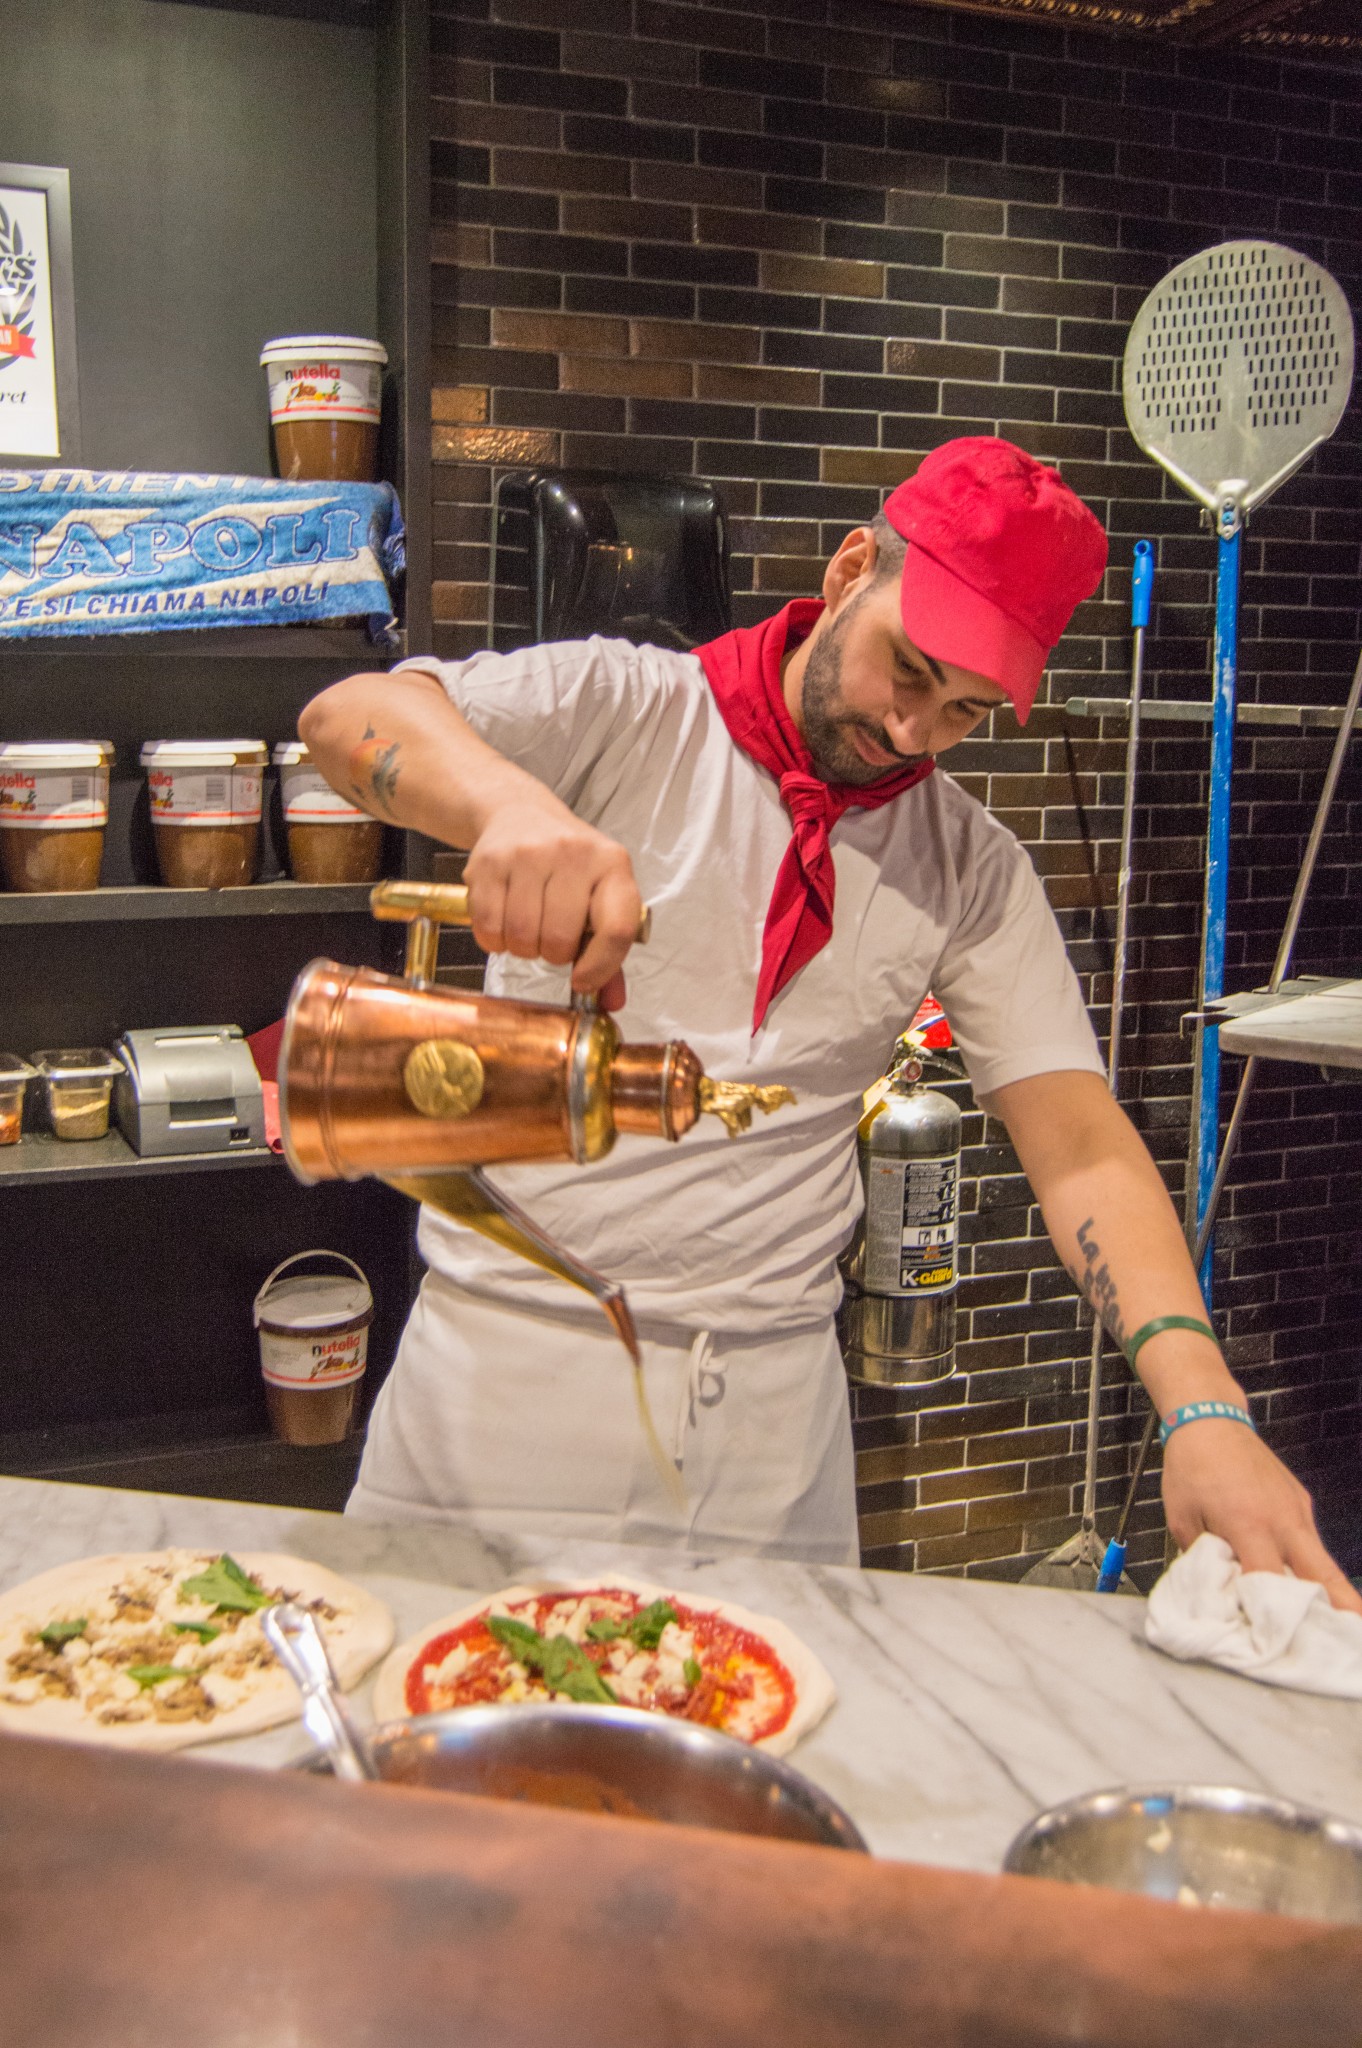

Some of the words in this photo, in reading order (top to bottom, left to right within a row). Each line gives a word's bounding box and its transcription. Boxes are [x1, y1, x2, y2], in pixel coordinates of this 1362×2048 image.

[285, 364, 341, 381] nutella
[44, 596, 75, 616] SI
[87, 591, 208, 615] CHIAMA
[219, 581, 330, 609] NAPOLI
[0, 772, 36, 789] tella
[312, 1335, 360, 1357] nutella
